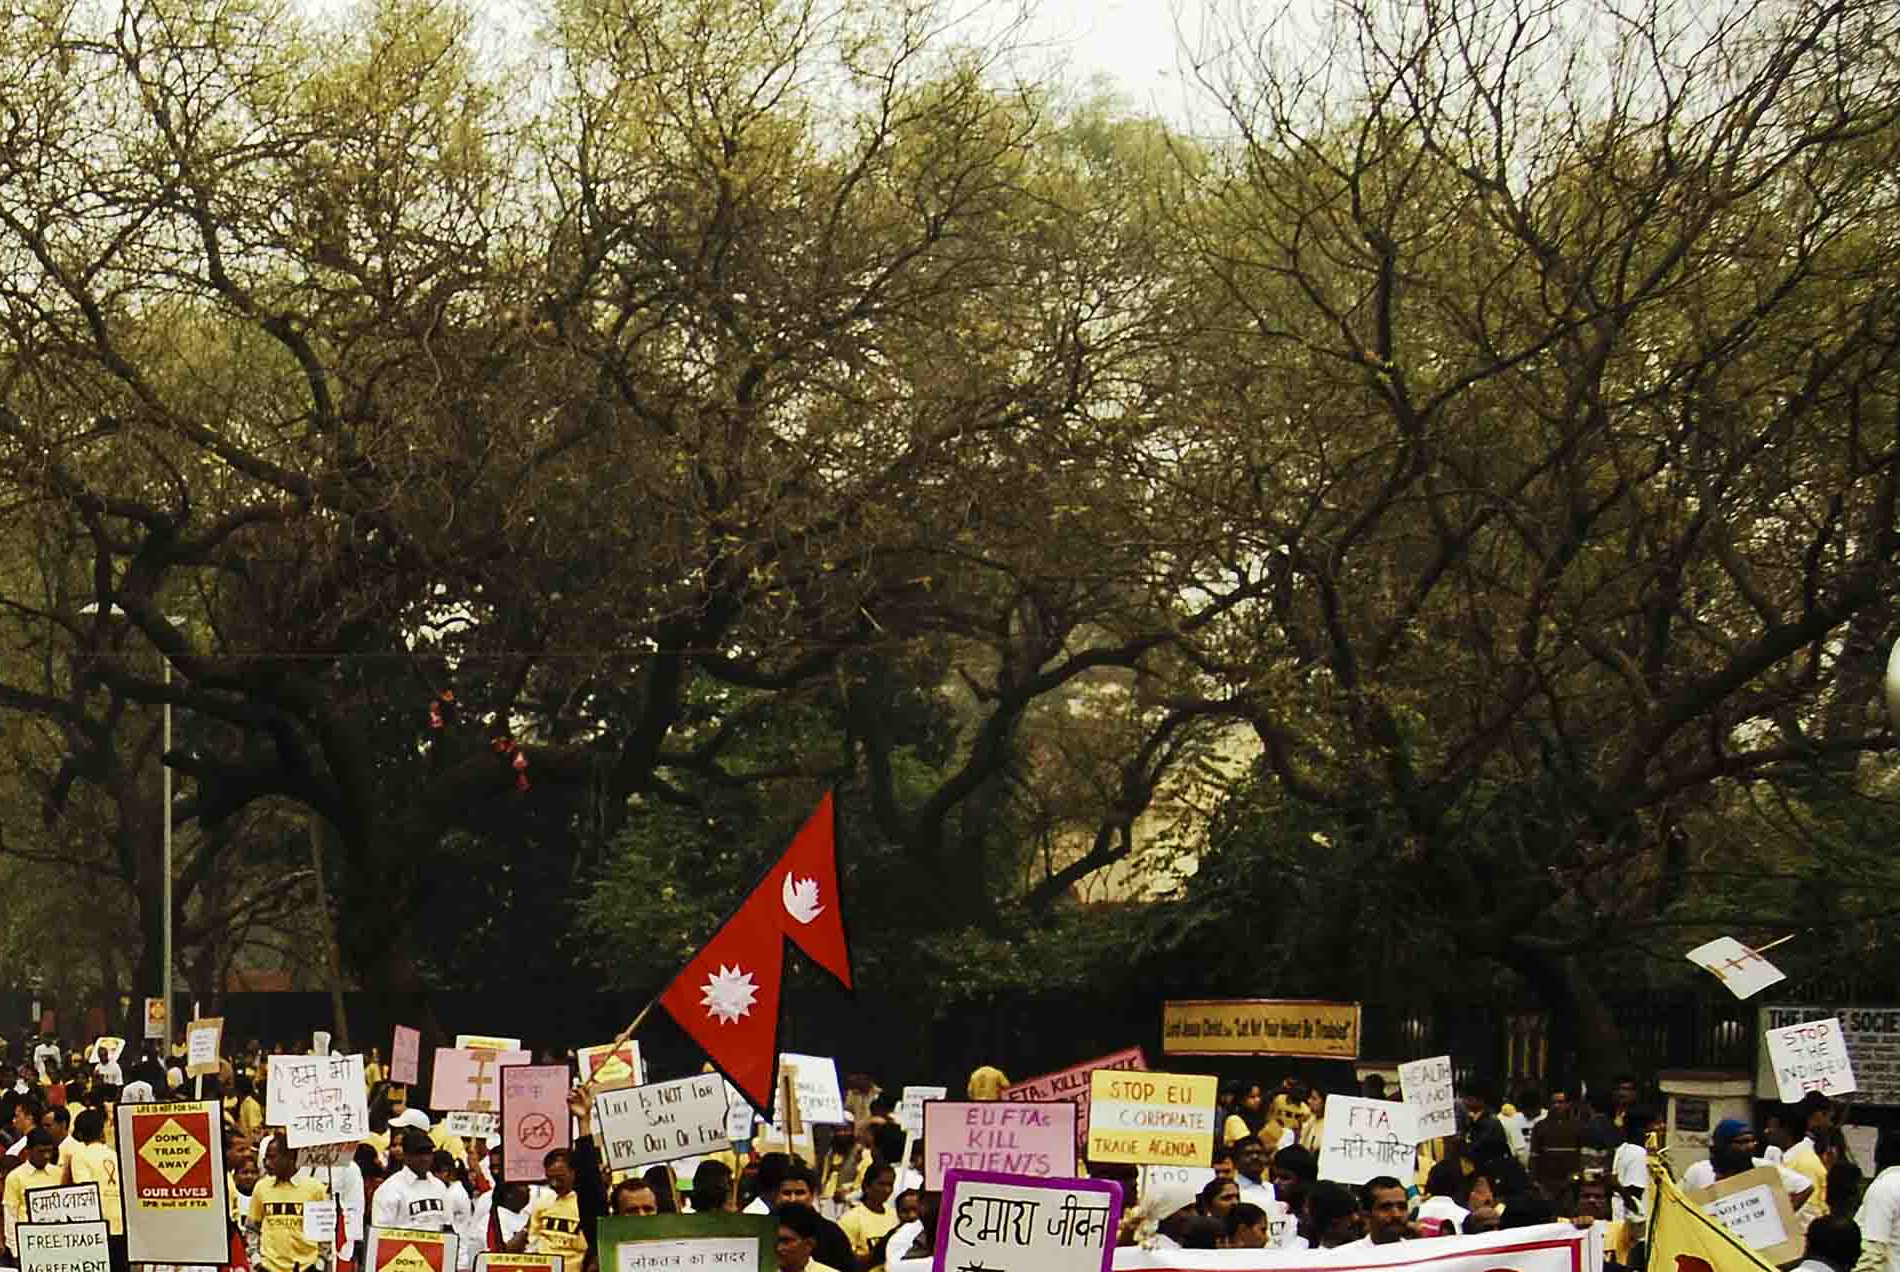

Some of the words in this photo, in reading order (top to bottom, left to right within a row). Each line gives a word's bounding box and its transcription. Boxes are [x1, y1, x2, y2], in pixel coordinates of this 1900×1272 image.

[1110, 1082, 1154, 1100] STOP
[1168, 1087, 1192, 1104] EU
[966, 1108, 994, 1126] EU
[155, 1134, 188, 1143] DON'T
[969, 1131, 1020, 1148] KILL
[154, 1147, 191, 1156] TRADE
[158, 1160, 189, 1169] AWAY
[938, 1152, 1049, 1174] PATIENTS
[142, 1188, 169, 1197] OUR
[171, 1188, 208, 1196] LIVES
[27, 1234, 64, 1250] FREE
[65, 1233, 105, 1248] TRADE
